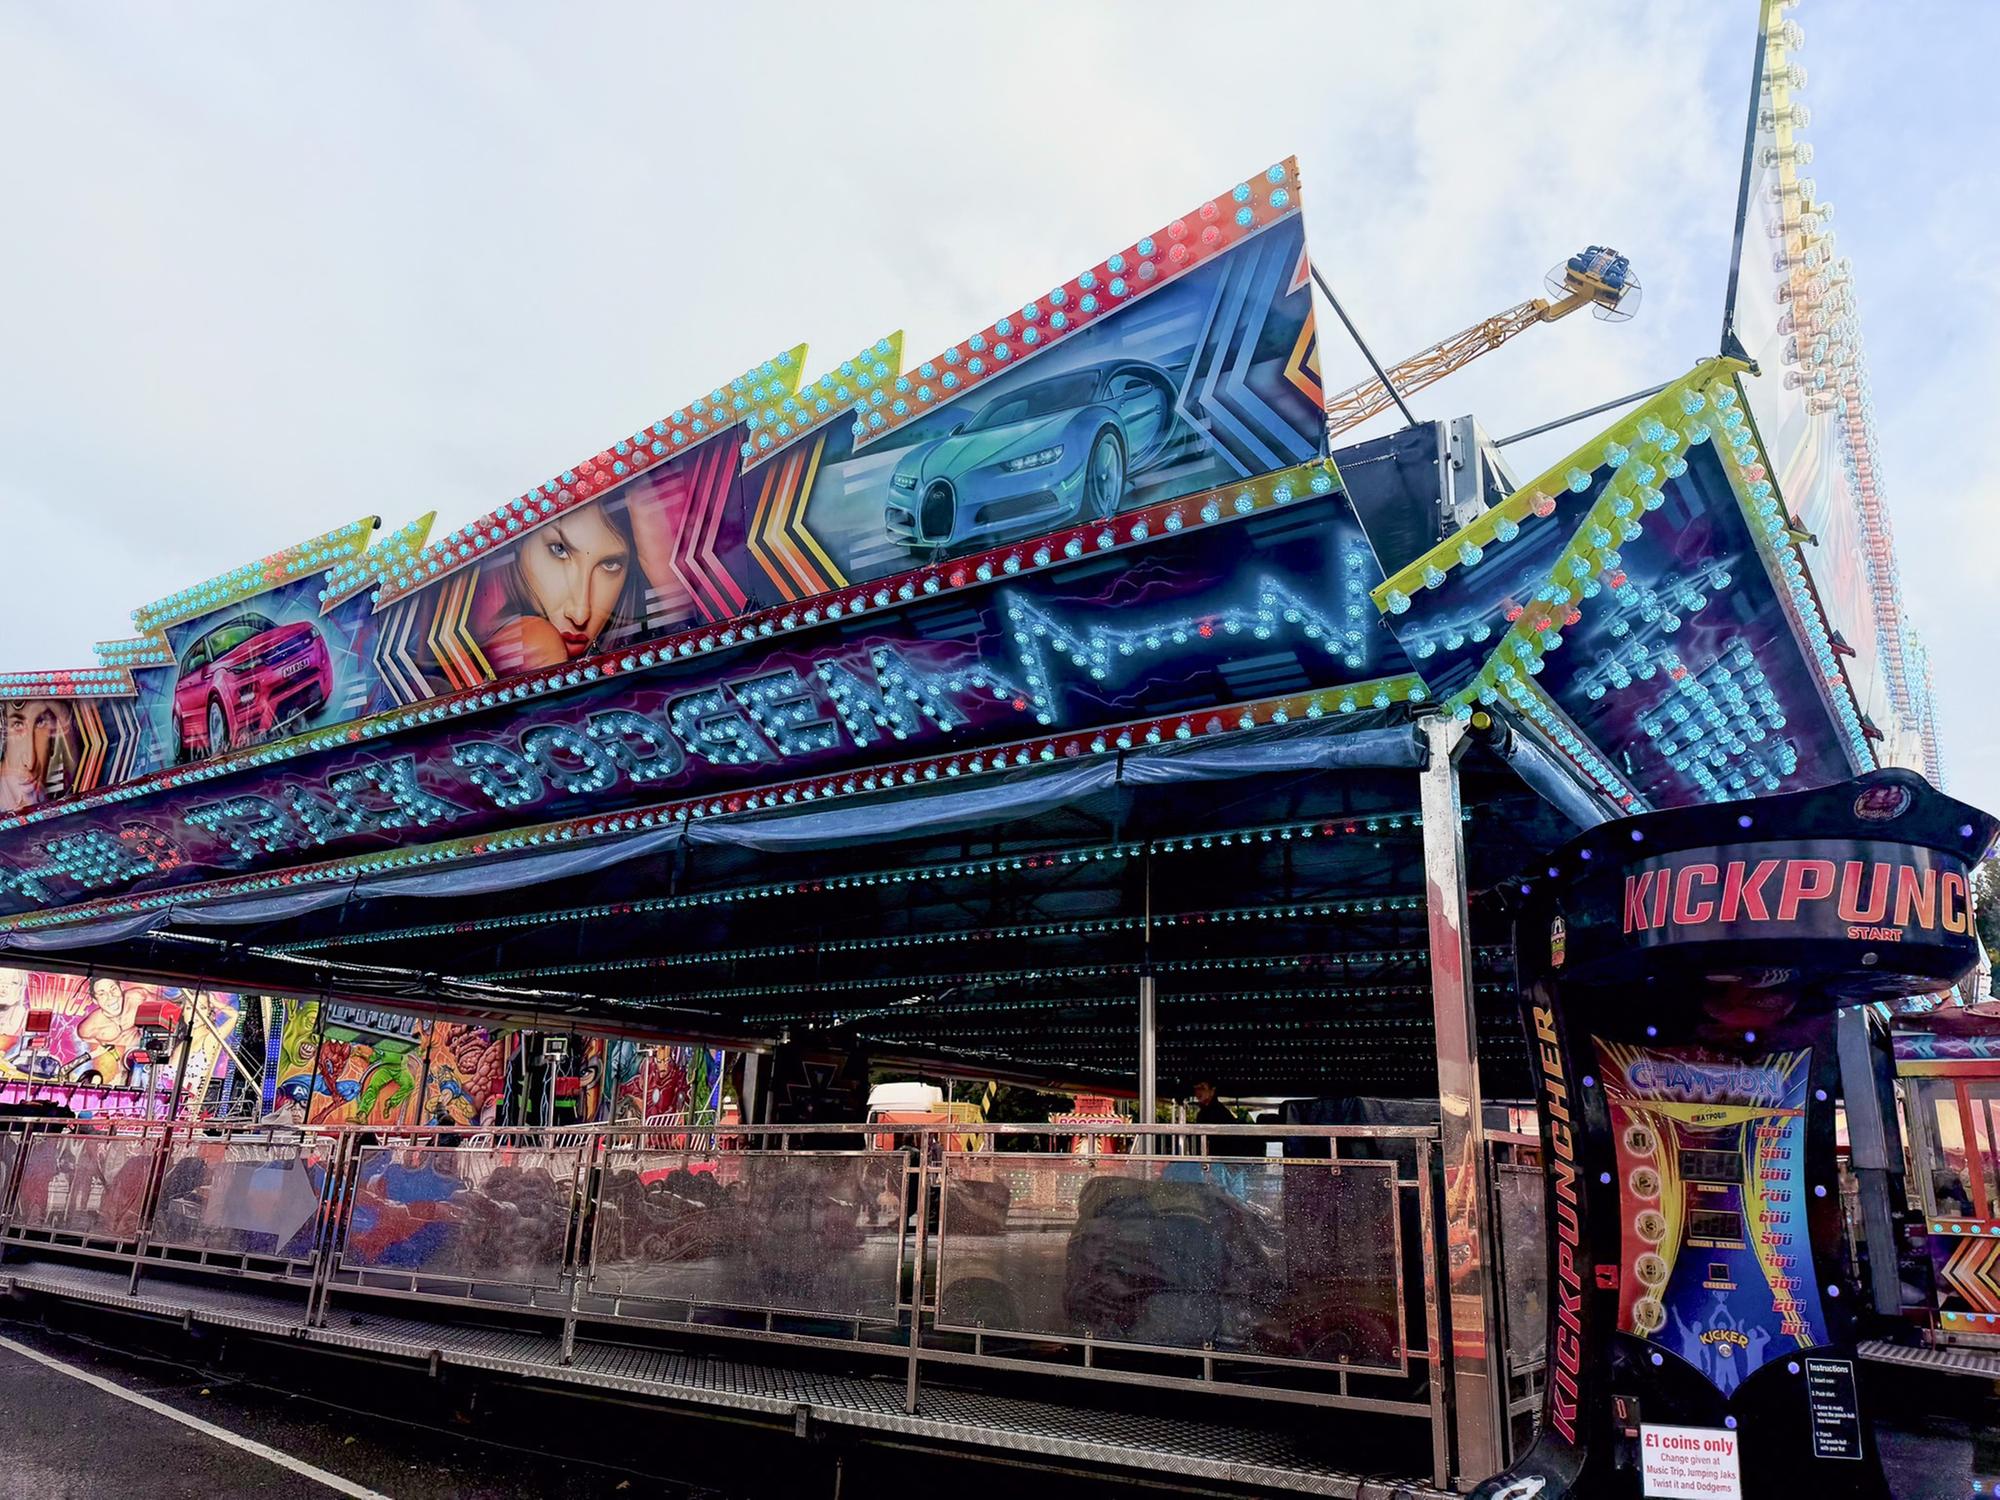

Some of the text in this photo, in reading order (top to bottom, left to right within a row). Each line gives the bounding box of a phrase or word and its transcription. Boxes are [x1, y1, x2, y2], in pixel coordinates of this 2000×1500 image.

[450, 642, 972, 800] DODGEM
[1847, 925, 1903, 941] START
[27, 973, 93, 1017] DANCE
[1629, 1061, 1783, 1097] CHAMPION
[1532, 1006, 1582, 1445] KICKPUNCHER
[1699, 1328, 1749, 1349] KICKER
[1809, 1363, 1849, 1373] Instructions
[1645, 1433, 1733, 1457] £1 coins only
[1660, 1452, 1721, 1466] Change given at
[1646, 1465, 1737, 1481] Music Trip, Jumping Jaks
[1652, 1478, 1732, 1494] Twist it and Dodgems
